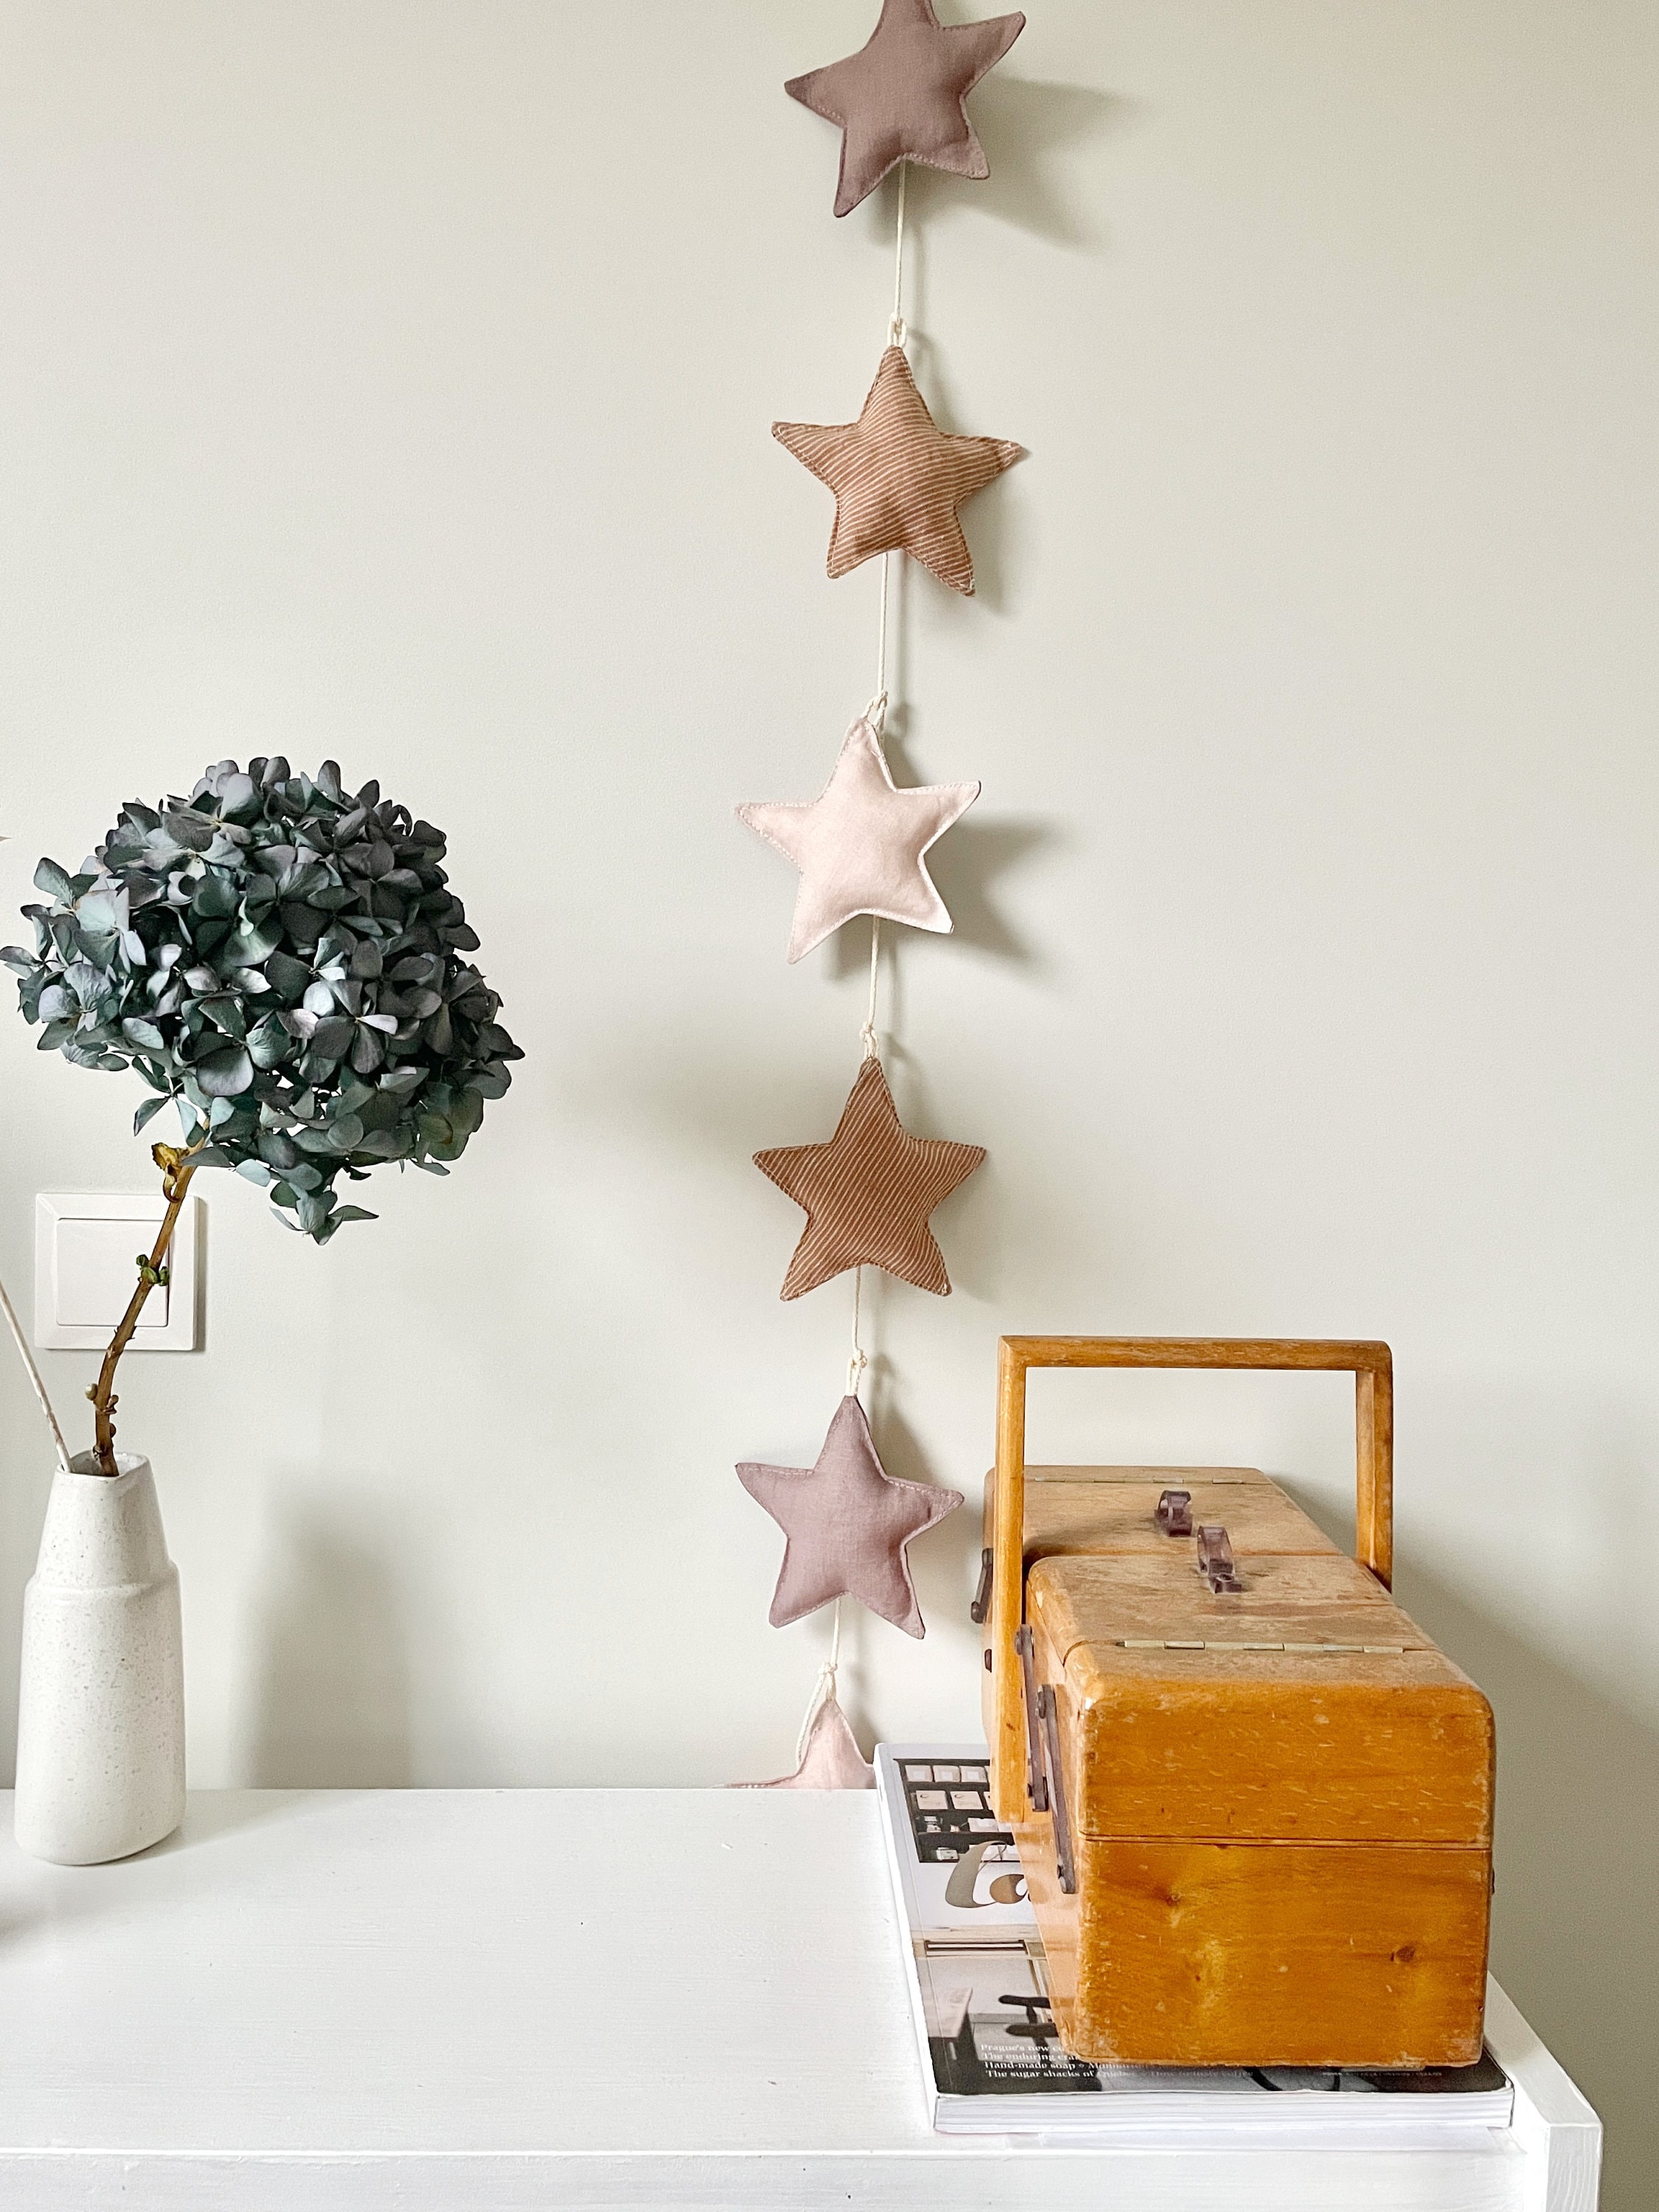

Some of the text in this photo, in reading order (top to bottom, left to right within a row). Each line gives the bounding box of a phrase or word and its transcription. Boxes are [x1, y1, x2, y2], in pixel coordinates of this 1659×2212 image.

[981, 2045, 1025, 2053] Prague's
[1006, 2053, 1055, 2062] enduring
[1050, 2062, 1076, 2070] soap
